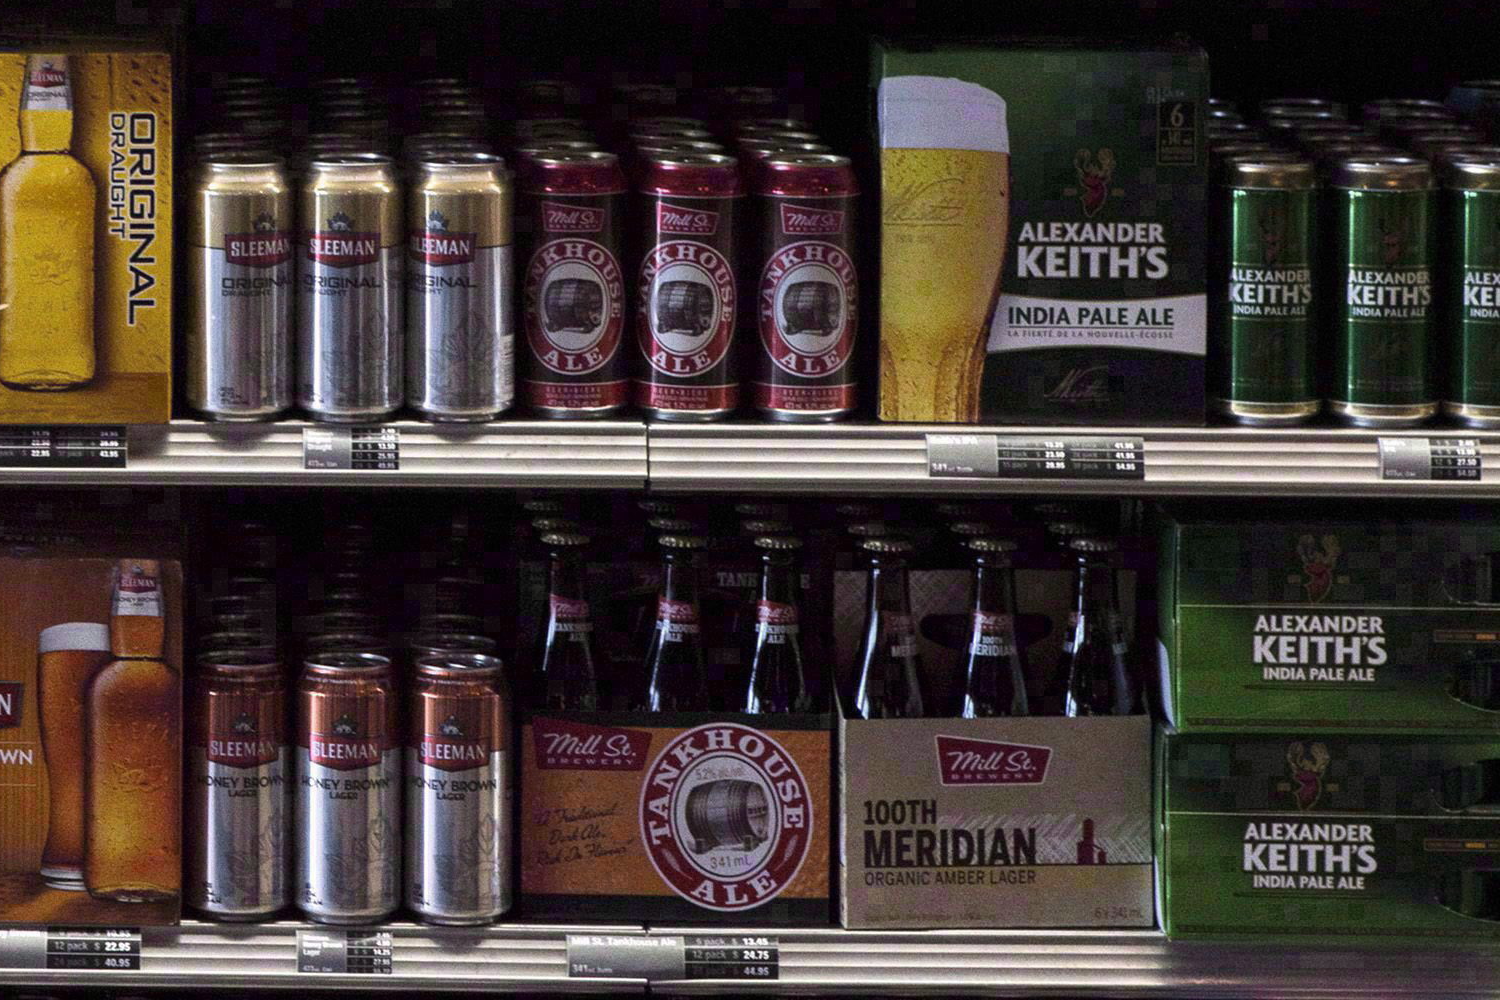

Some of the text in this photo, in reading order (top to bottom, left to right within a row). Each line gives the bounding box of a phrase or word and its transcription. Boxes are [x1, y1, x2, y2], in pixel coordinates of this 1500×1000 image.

[109, 113, 127, 238] DRAUGHT
[128, 112, 156, 325] ORIGINAL
[1018, 222, 1164, 244] ALEXANDER
[310, 238, 374, 256] SLEEMAN
[1017, 245, 1168, 280] KEITH'S
[1348, 271, 1430, 284] ALEXANDER
[1347, 285, 1430, 305] KEITH'S
[1008, 307, 1174, 326] INDIA PALE ALE
[652, 350, 712, 373] ALE
[780, 350, 840, 373] ALE
[1255, 615, 1384, 634] ALEXANDER
[1253, 637, 1387, 665] KEITH'S
[1263, 667, 1375, 682] INDIA PALE ALE
[313, 741, 378, 758] SLEEMAN
[543, 732, 636, 757] Mill St.
[548, 758, 634, 766] BREWERY
[948, 751, 1036, 772] Mill St.
[650, 729, 804, 846] TANKHOUSE
[864, 800, 936, 824] 100TH
[1245, 823, 1372, 842] ALEXANDER
[864, 828, 1036, 867] MERIDIAN
[1243, 845, 1377, 873] KEITH'S
[690, 870, 777, 905] ALE
[865, 870, 1036, 886] ORGANIC AMBER LAGER
[55, 941, 64, 950] 12
[67, 941, 87, 951] pack
[105, 941, 130, 951] 22.95
[743, 950, 769, 960] 24.75
